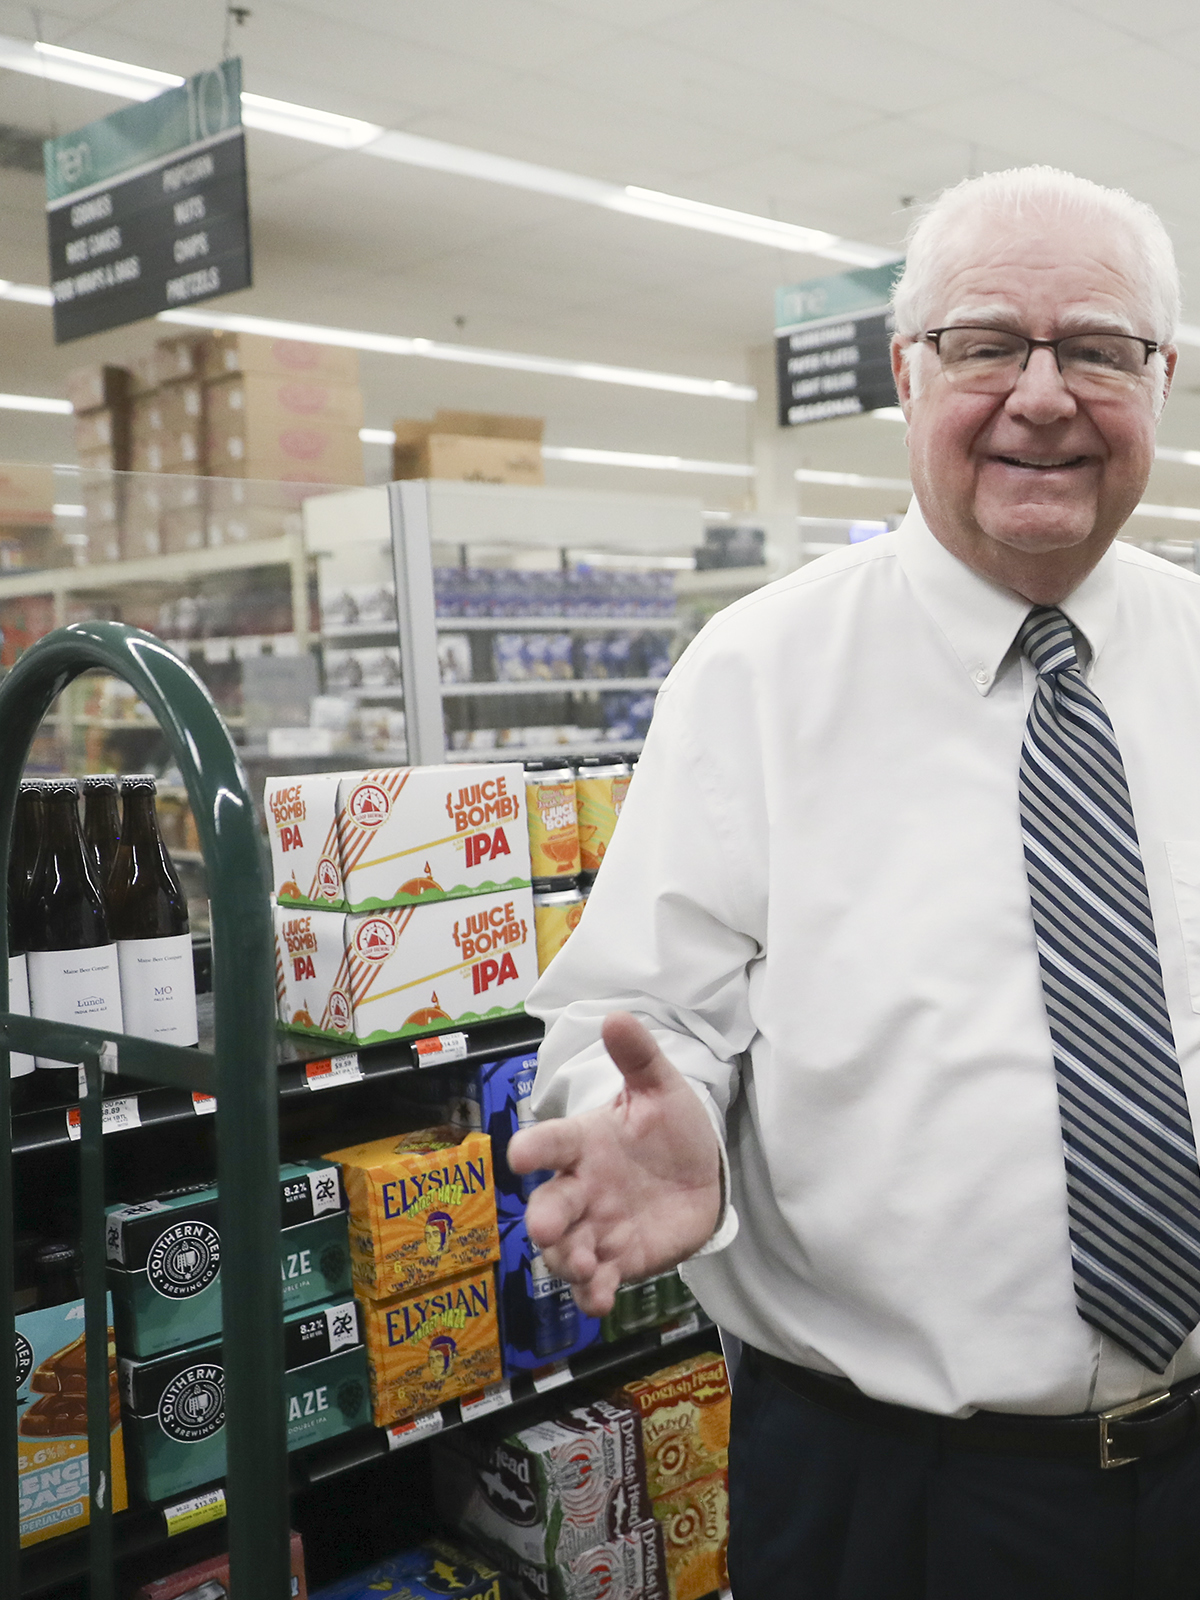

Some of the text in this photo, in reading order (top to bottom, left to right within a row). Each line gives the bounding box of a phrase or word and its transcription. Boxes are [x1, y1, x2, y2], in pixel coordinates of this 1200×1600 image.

[173, 194, 206, 226] NUTS
[173, 231, 210, 264] CHIPS
[166, 266, 221, 303] PRETZELS
[280, 824, 304, 853] IPA
[465, 826, 511, 868] IPA
[293, 955, 317, 982] IPA
[472, 951, 519, 995] IPA
[77, 997, 105, 1007] Lunch
[154, 985, 172, 996] MO
[283, 1182, 307, 1197] 8.2%
[382, 1157, 486, 1220] ELYSIAN
[437, 1184, 465, 1206] HAZE
[151, 1225, 220, 1279] SOUTHERN TIER
[281, 1249, 312, 1281] ZE
[163, 1281, 203, 1294] BREWING
[299, 1319, 324, 1335] 8.2%
[385, 1279, 489, 1348] ELYSIAN
[441, 1308, 468, 1330] HAZE
[163, 1367, 217, 1423] SOUTHERN
[639, 1364, 724, 1409] Dogfish Head
[288, 1385, 329, 1422] AZE
[174, 1423, 215, 1437] BREWING
[288, 1416, 327, 1435] DOUBLE IPA
[620, 1416, 643, 1528] Dogfish Head
[194, 1496, 218, 1510] $13.99
[20, 1504, 80, 1534] PERIAL ALE
